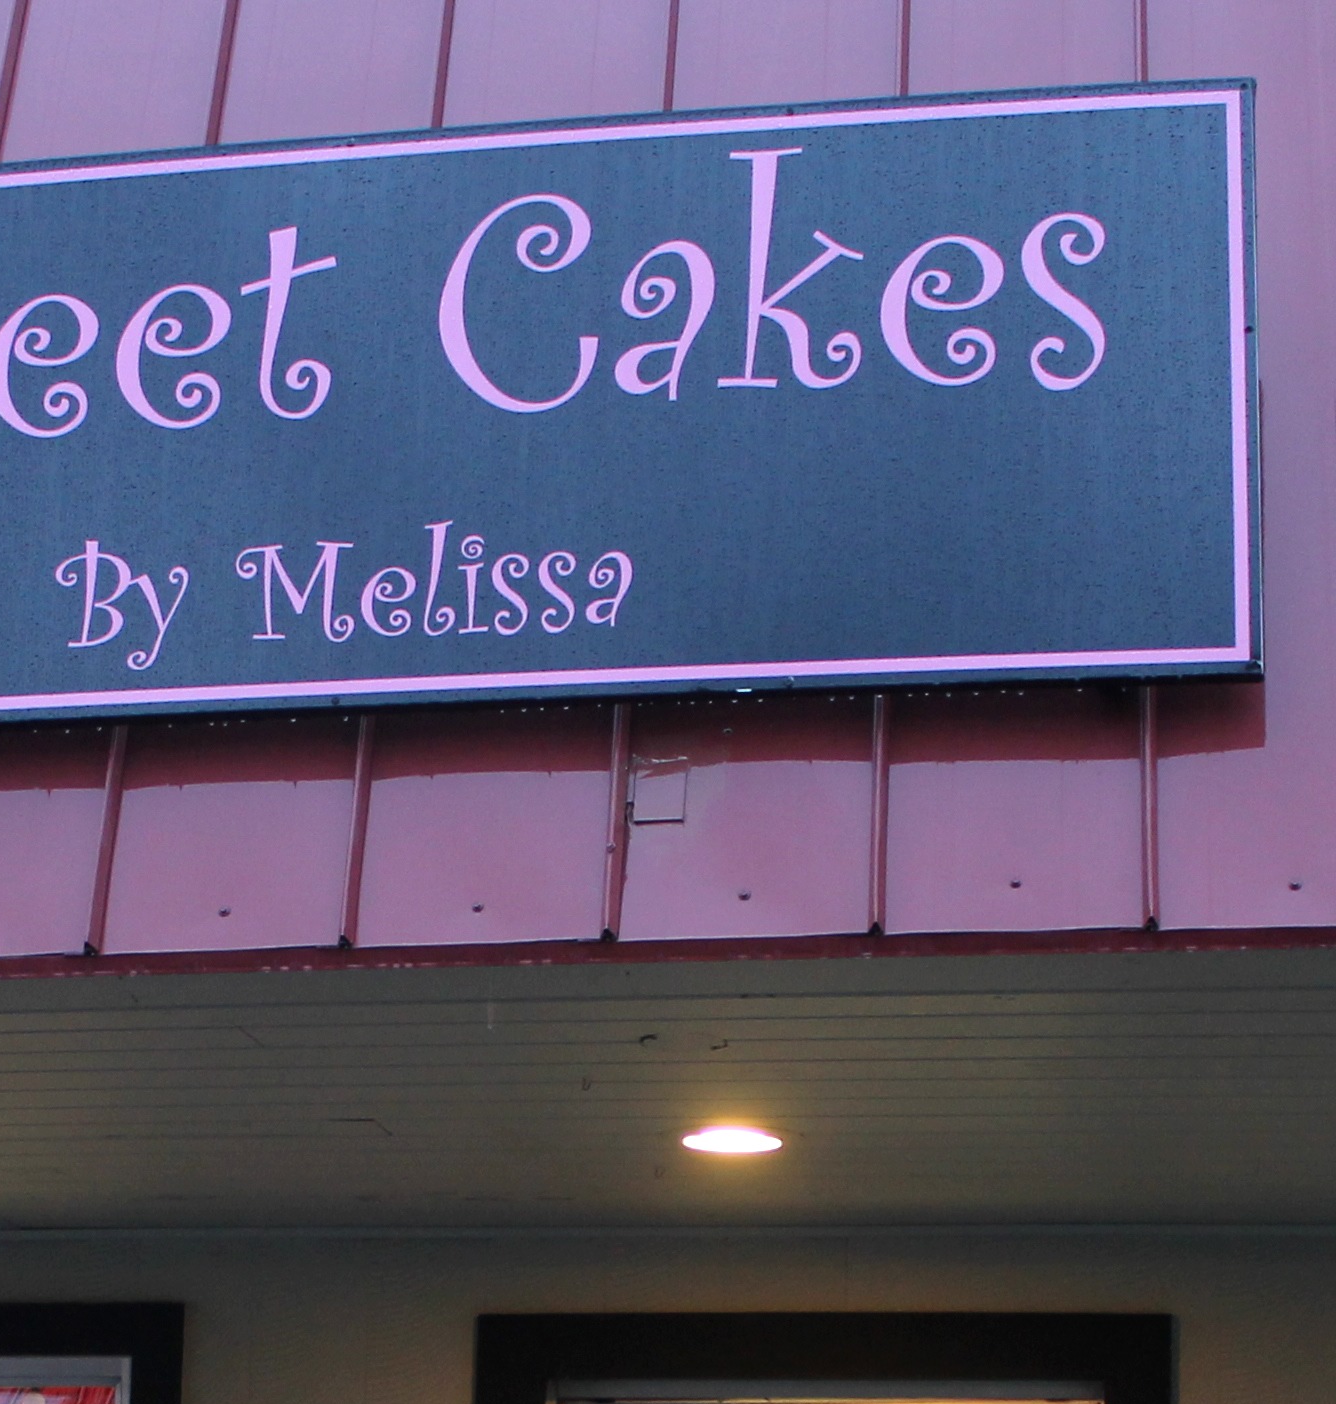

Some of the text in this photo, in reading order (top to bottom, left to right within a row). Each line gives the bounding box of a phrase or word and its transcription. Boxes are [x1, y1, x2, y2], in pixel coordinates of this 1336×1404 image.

[437, 147, 1106, 412] Cakes
[55, 520, 633, 671] By Melissa
